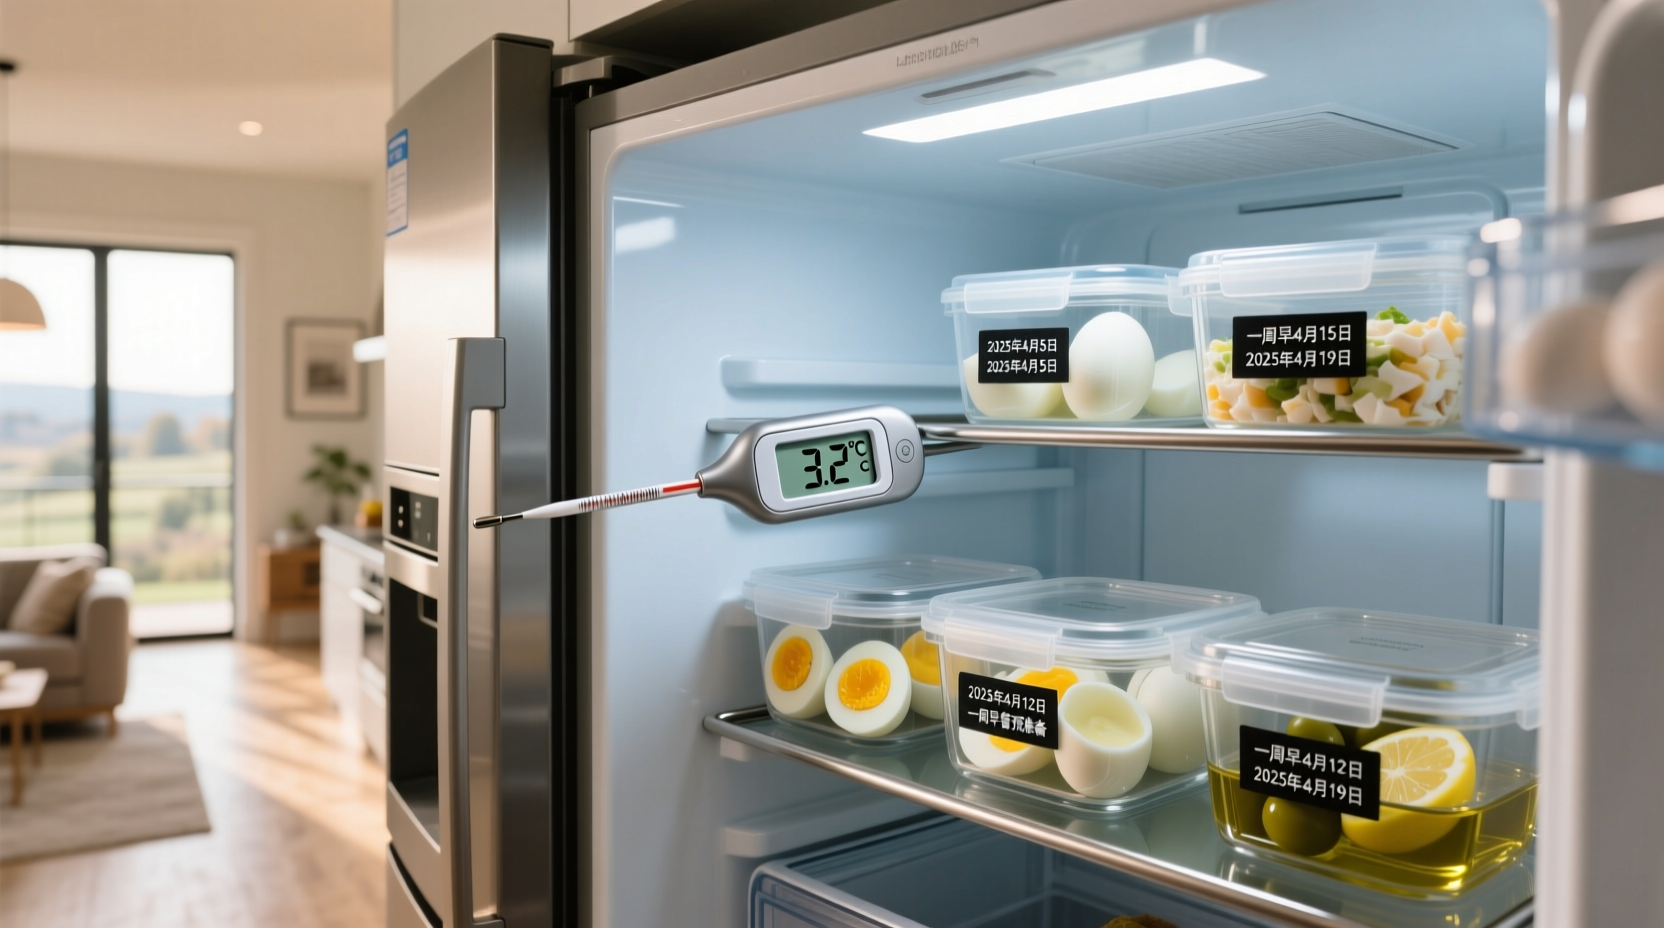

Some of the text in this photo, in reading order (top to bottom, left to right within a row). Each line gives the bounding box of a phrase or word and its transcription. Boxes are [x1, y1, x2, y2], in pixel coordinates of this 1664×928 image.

[1245, 349, 1351, 368] 2025年4月19日
[968, 685, 1046, 714] 2025年4月12日
[1253, 766, 1362, 806] 2025年4月19日
